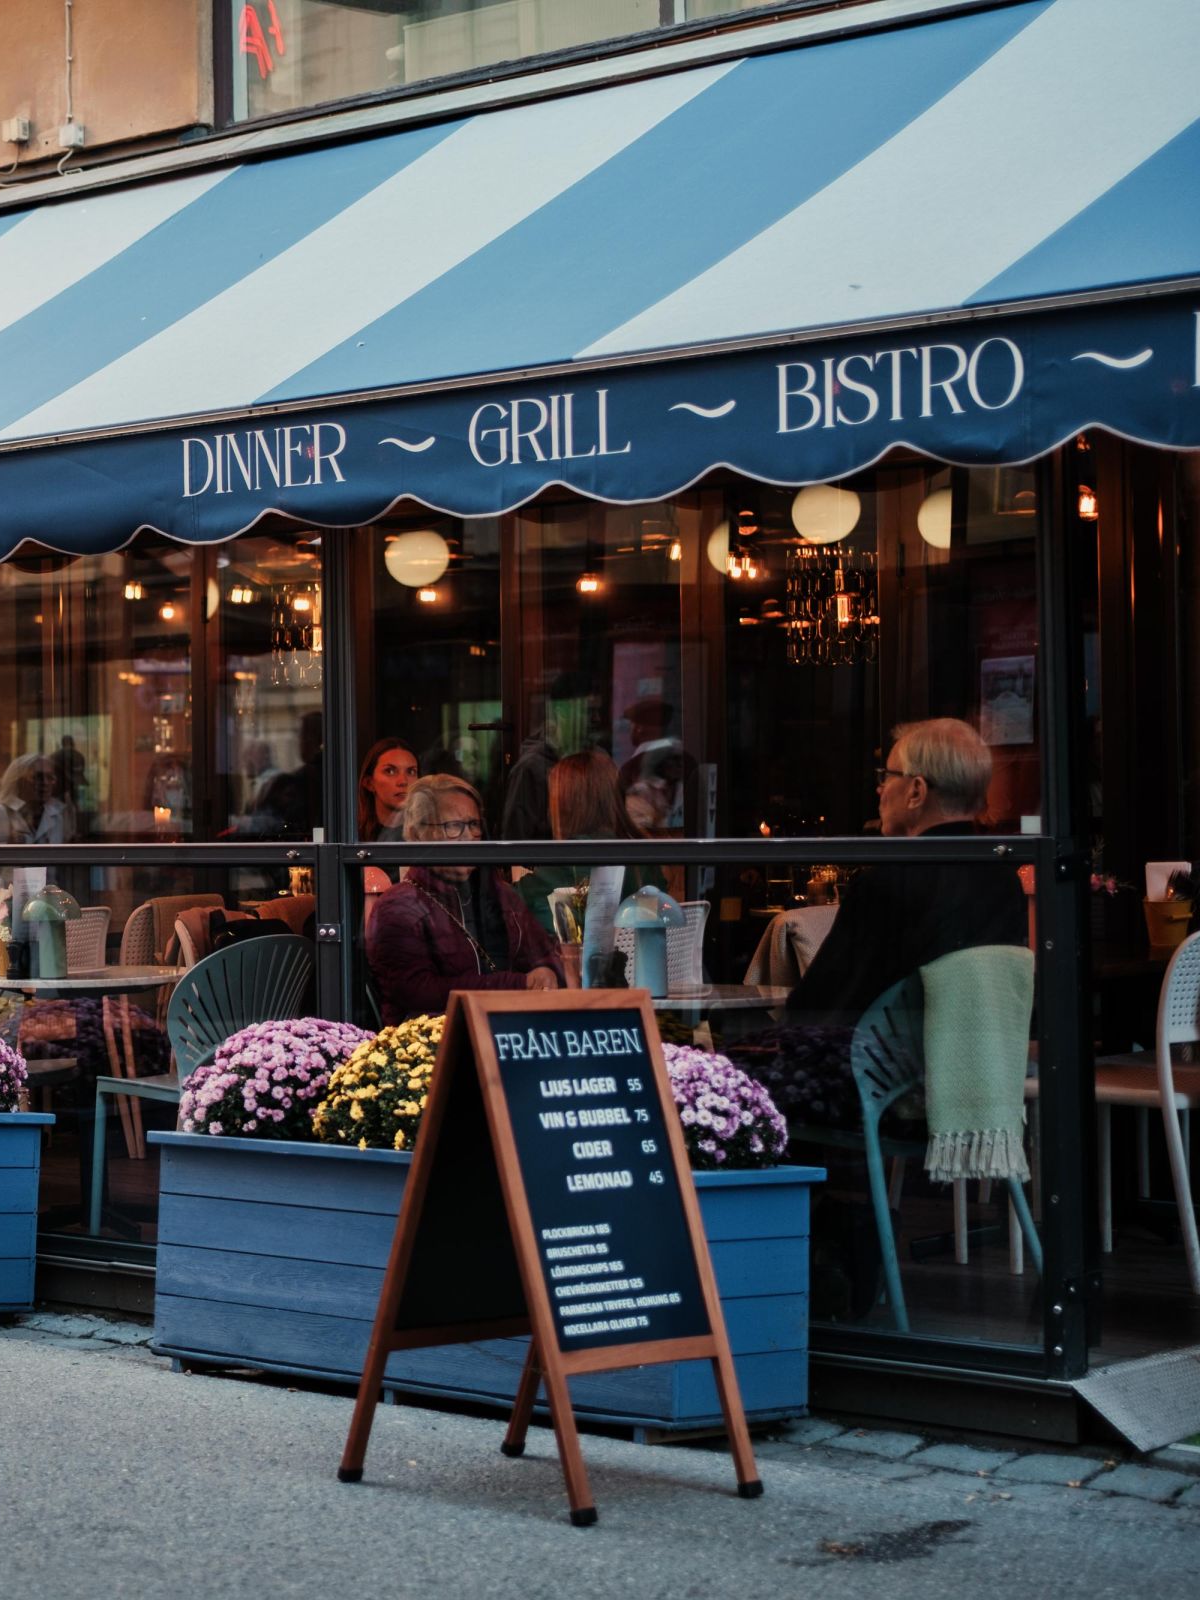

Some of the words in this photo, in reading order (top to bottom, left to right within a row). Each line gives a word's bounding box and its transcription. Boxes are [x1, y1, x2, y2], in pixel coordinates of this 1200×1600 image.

[181, 421, 347, 498] DINNER
[468, 387, 632, 469] GRILL
[775, 336, 1026, 436] BISTRO
[495, 1028, 561, 1059] FRÅN
[564, 1028, 643, 1055] BAREN
[540, 1079, 573, 1097] LJUS
[573, 1076, 617, 1094] LAGER
[628, 1078, 642, 1091] 55
[539, 1111, 565, 1128] VIN
[565, 1110, 578, 1126] &
[578, 1107, 631, 1126] BUBBEL
[635, 1109, 648, 1121] 75
[572, 1140, 613, 1158] CIDER
[641, 1139, 657, 1152] 65
[566, 1170, 634, 1191] LEMONAD
[649, 1170, 664, 1183] 45
[546, 1244, 596, 1259] BRUSCHETTA
[559, 1302, 604, 1315] PARMESAN
[604, 1298, 637, 1310] TRYFFEL
[637, 1294, 669, 1306] HONUNG
[564, 1320, 609, 1335] NOCELLARA
[610, 1316, 638, 1329] OLIVER
